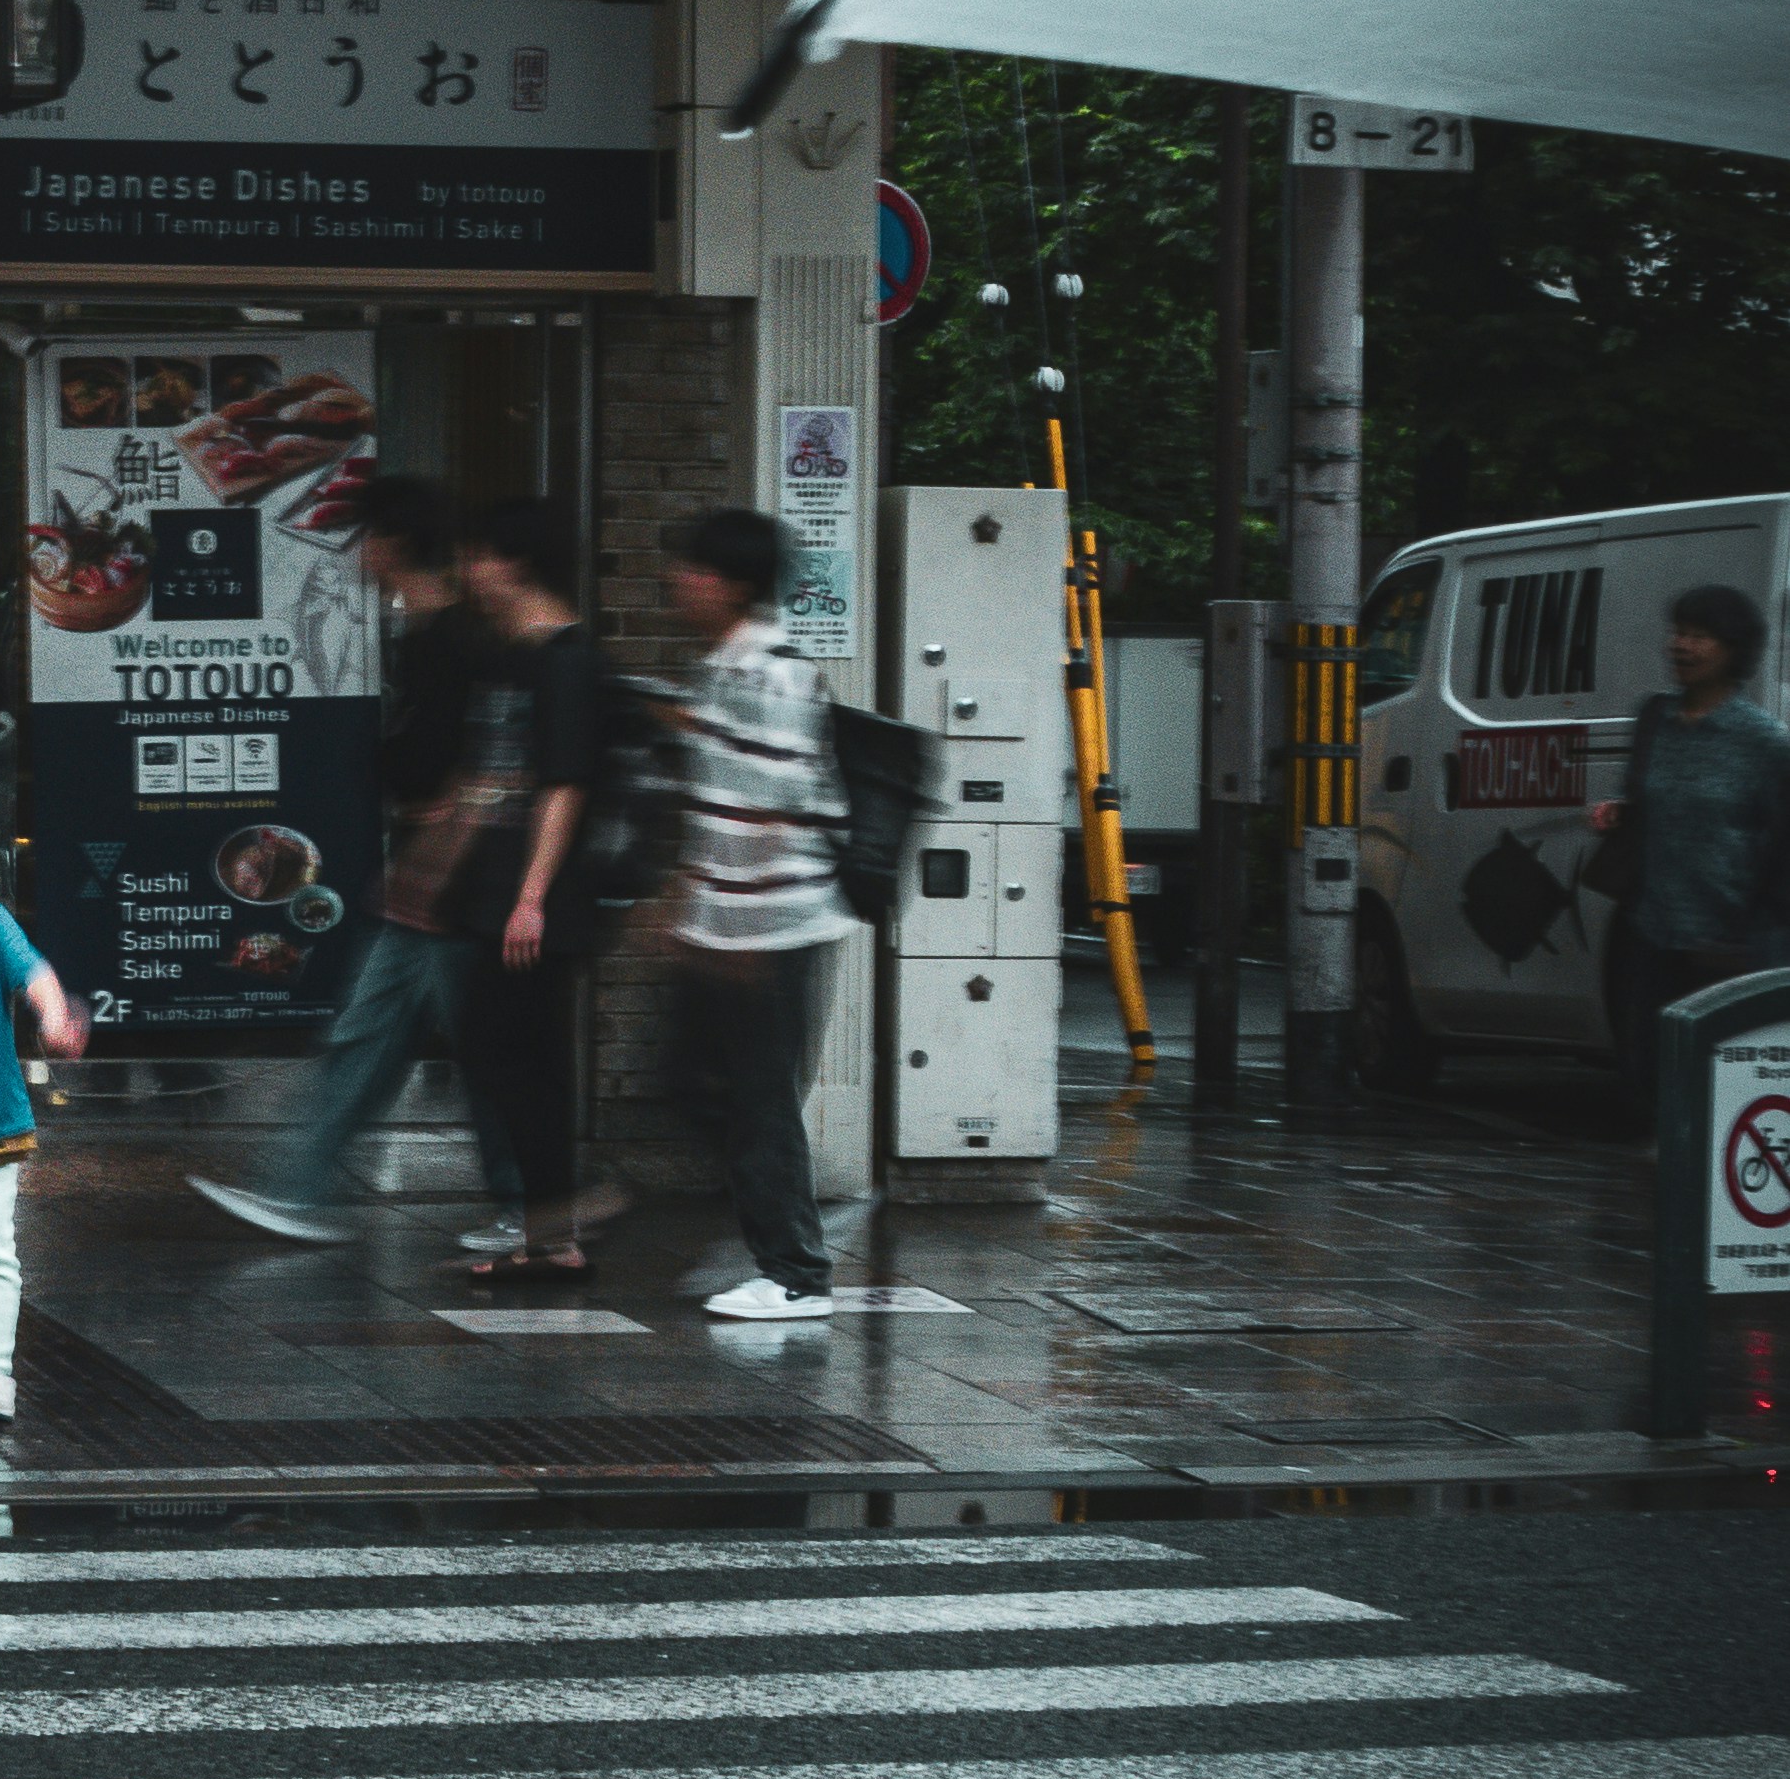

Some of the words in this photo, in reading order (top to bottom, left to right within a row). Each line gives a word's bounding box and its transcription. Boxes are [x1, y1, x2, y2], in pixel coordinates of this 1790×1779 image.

[139, 37, 479, 107] ととうお
[21, 164, 218, 205] Japanese
[232, 168, 371, 204] Dishes
[420, 180, 450, 208] by
[43, 211, 123, 234] Sushi
[155, 213, 280, 240] Tempura
[312, 217, 425, 238] Sashimi
[454, 220, 523, 240] Sake
[112, 434, 181, 504] 鮨
[113, 634, 251, 659] Welcome
[262, 633, 290, 657] to
[1475, 567, 1603, 700] TUNA
[115, 662, 293, 702] TOTOUO
[115, 707, 214, 729] Japanese
[218, 706, 291, 725] Dishes
[117, 872, 190, 894] Sushi
[119, 900, 233, 927] Tempura
[118, 929, 221, 952] Sashimi
[118, 959, 183, 980] Sake
[90, 989, 134, 1023] 2F
